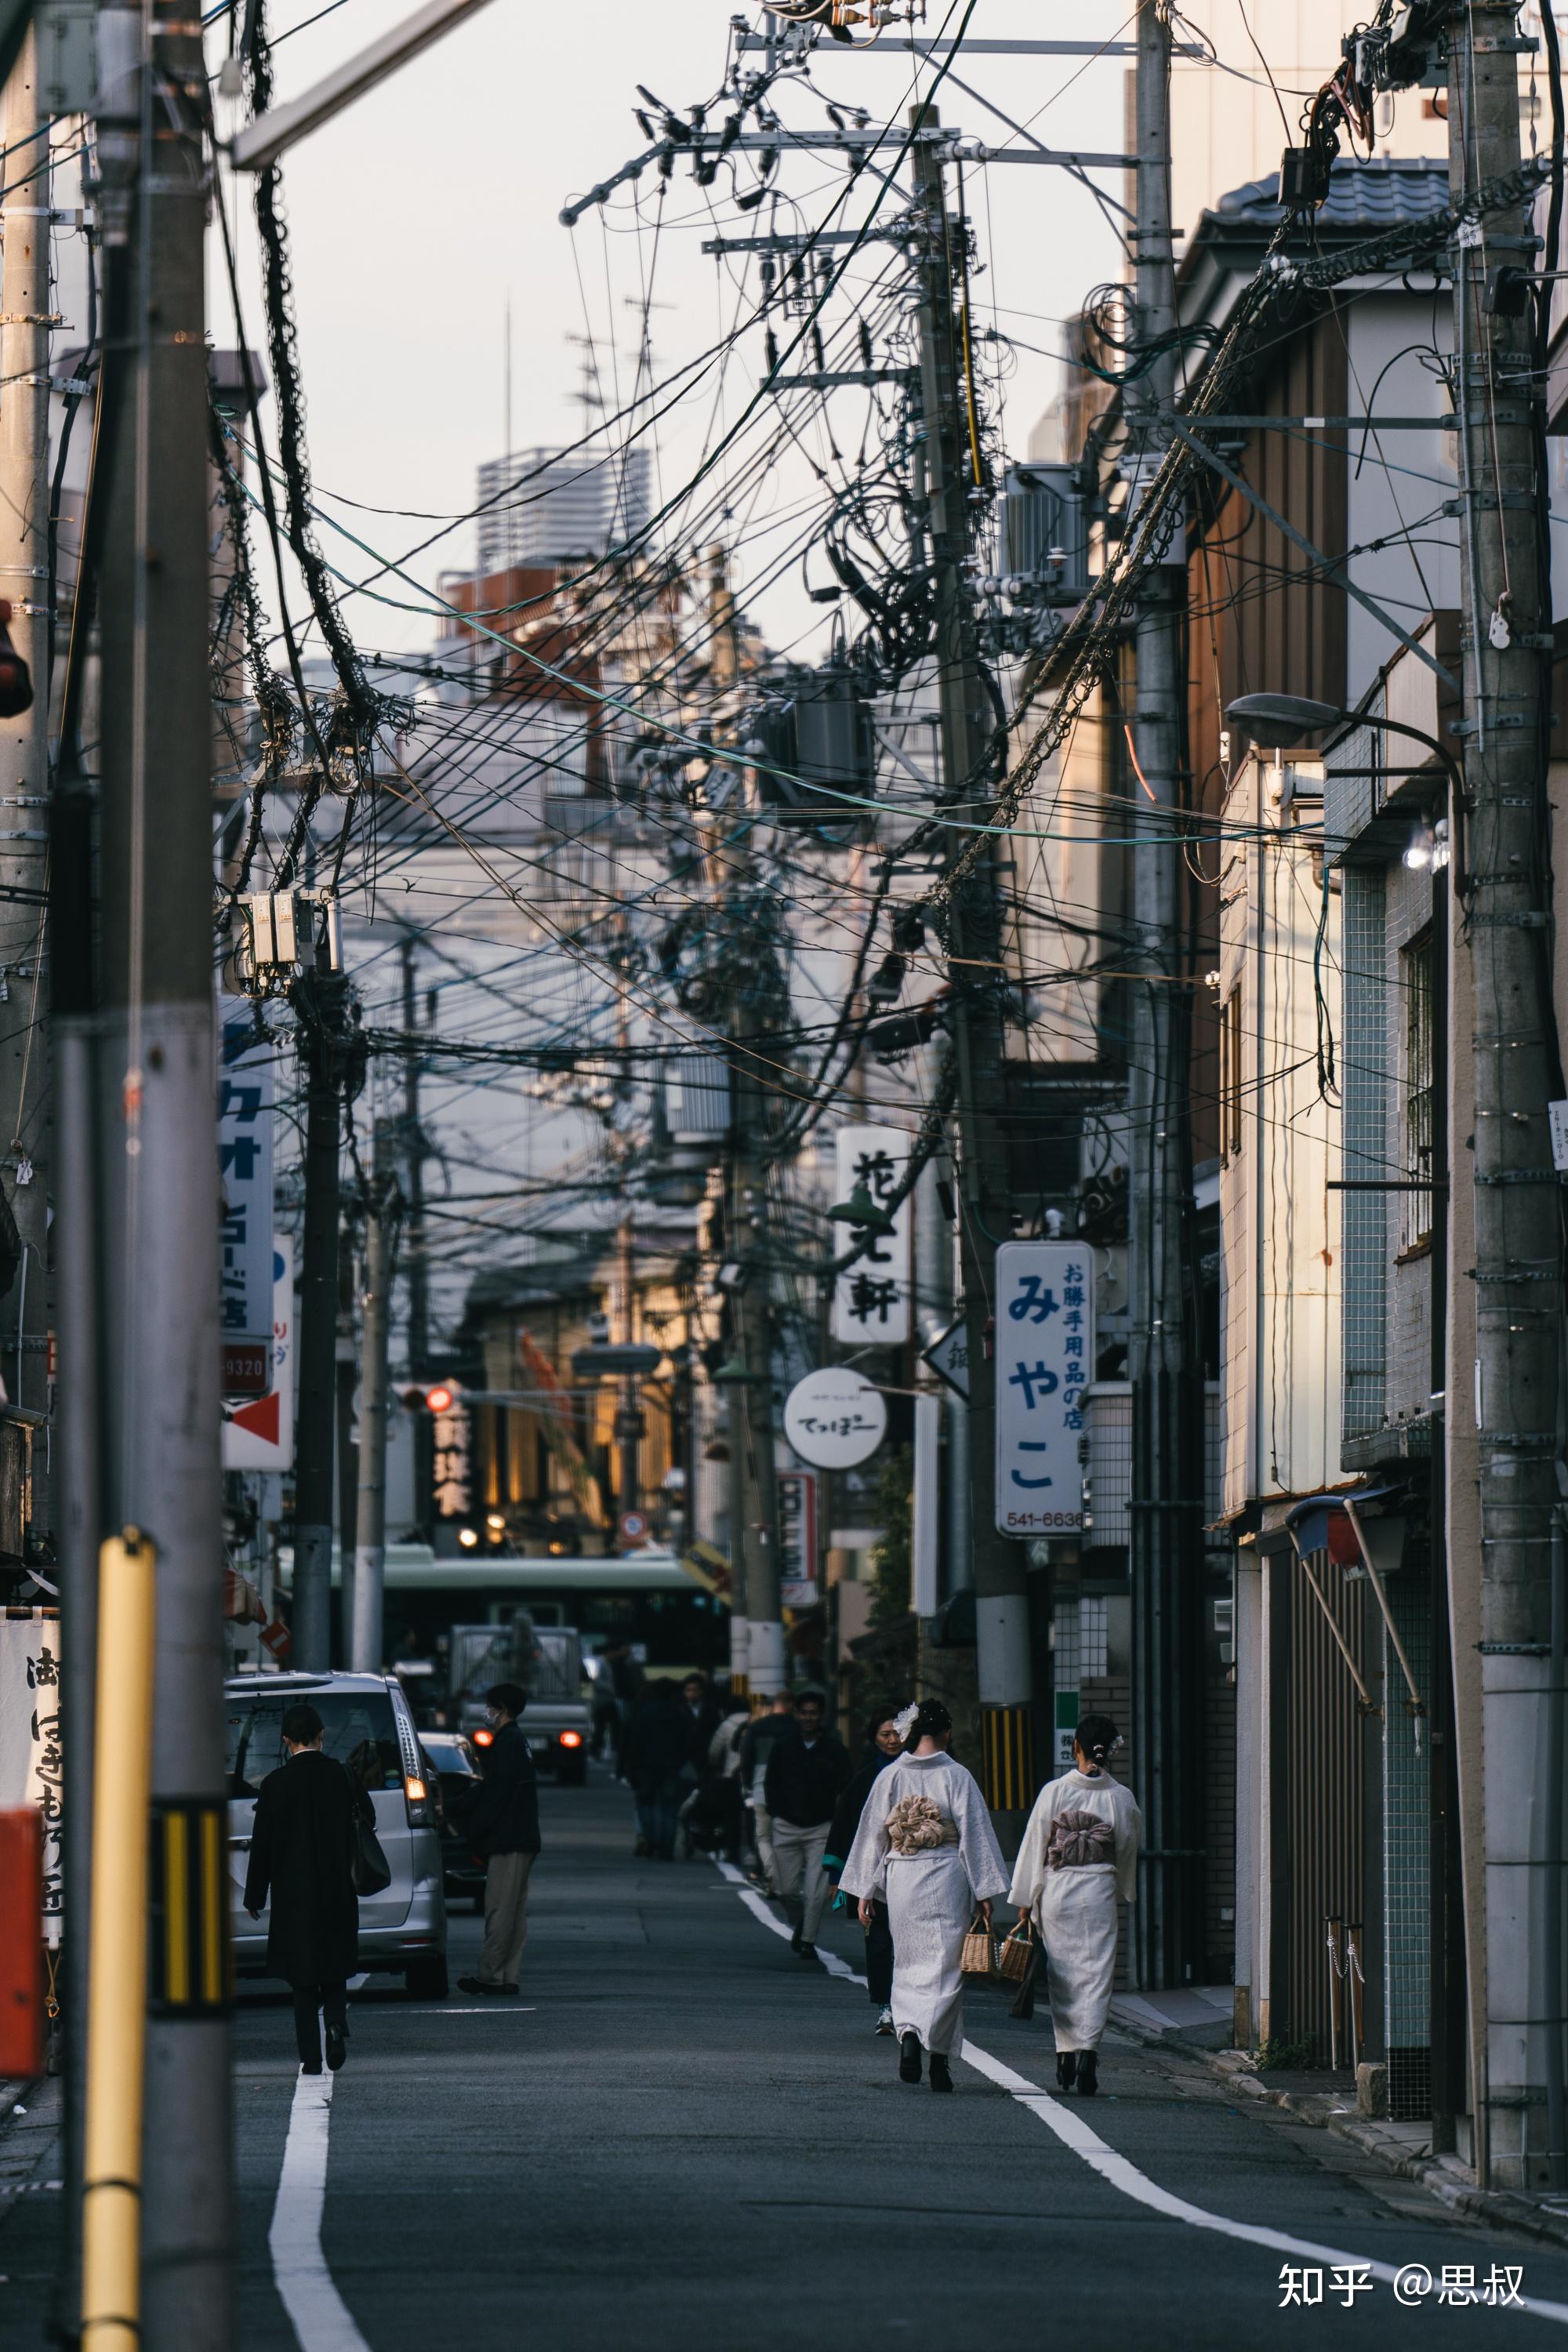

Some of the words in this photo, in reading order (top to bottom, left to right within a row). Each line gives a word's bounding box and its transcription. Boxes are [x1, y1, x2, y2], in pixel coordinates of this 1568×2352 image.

[1008, 1275, 1060, 1489] みやこ
[1062, 1263, 1085, 1431] お勝手用品の店
